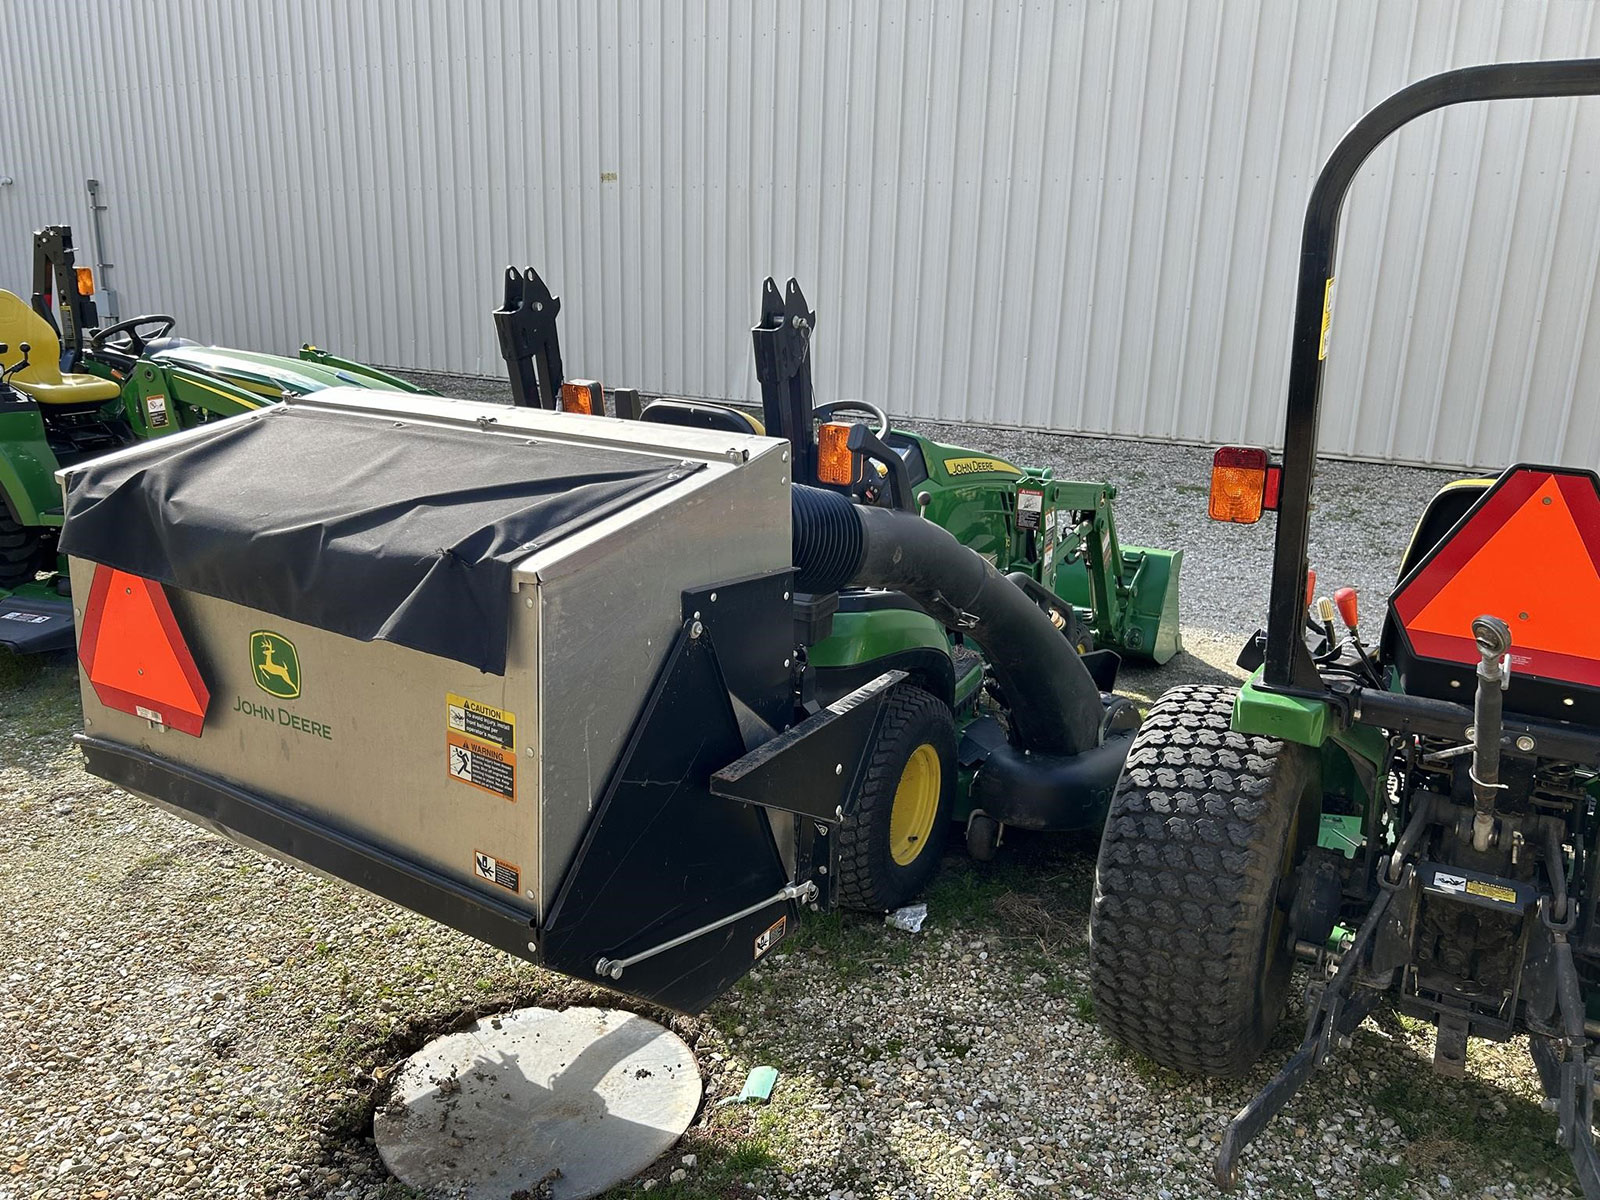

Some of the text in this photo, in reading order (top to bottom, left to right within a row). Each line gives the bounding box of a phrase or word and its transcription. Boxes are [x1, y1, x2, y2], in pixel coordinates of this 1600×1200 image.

[952, 461, 994, 475] JOHN DEERE
[233, 696, 332, 740] JOHN DEERE
[470, 703, 501, 719] CAUTION
[471, 743, 504, 761] WARNING
[1480, 880, 1513, 892] WARNING
